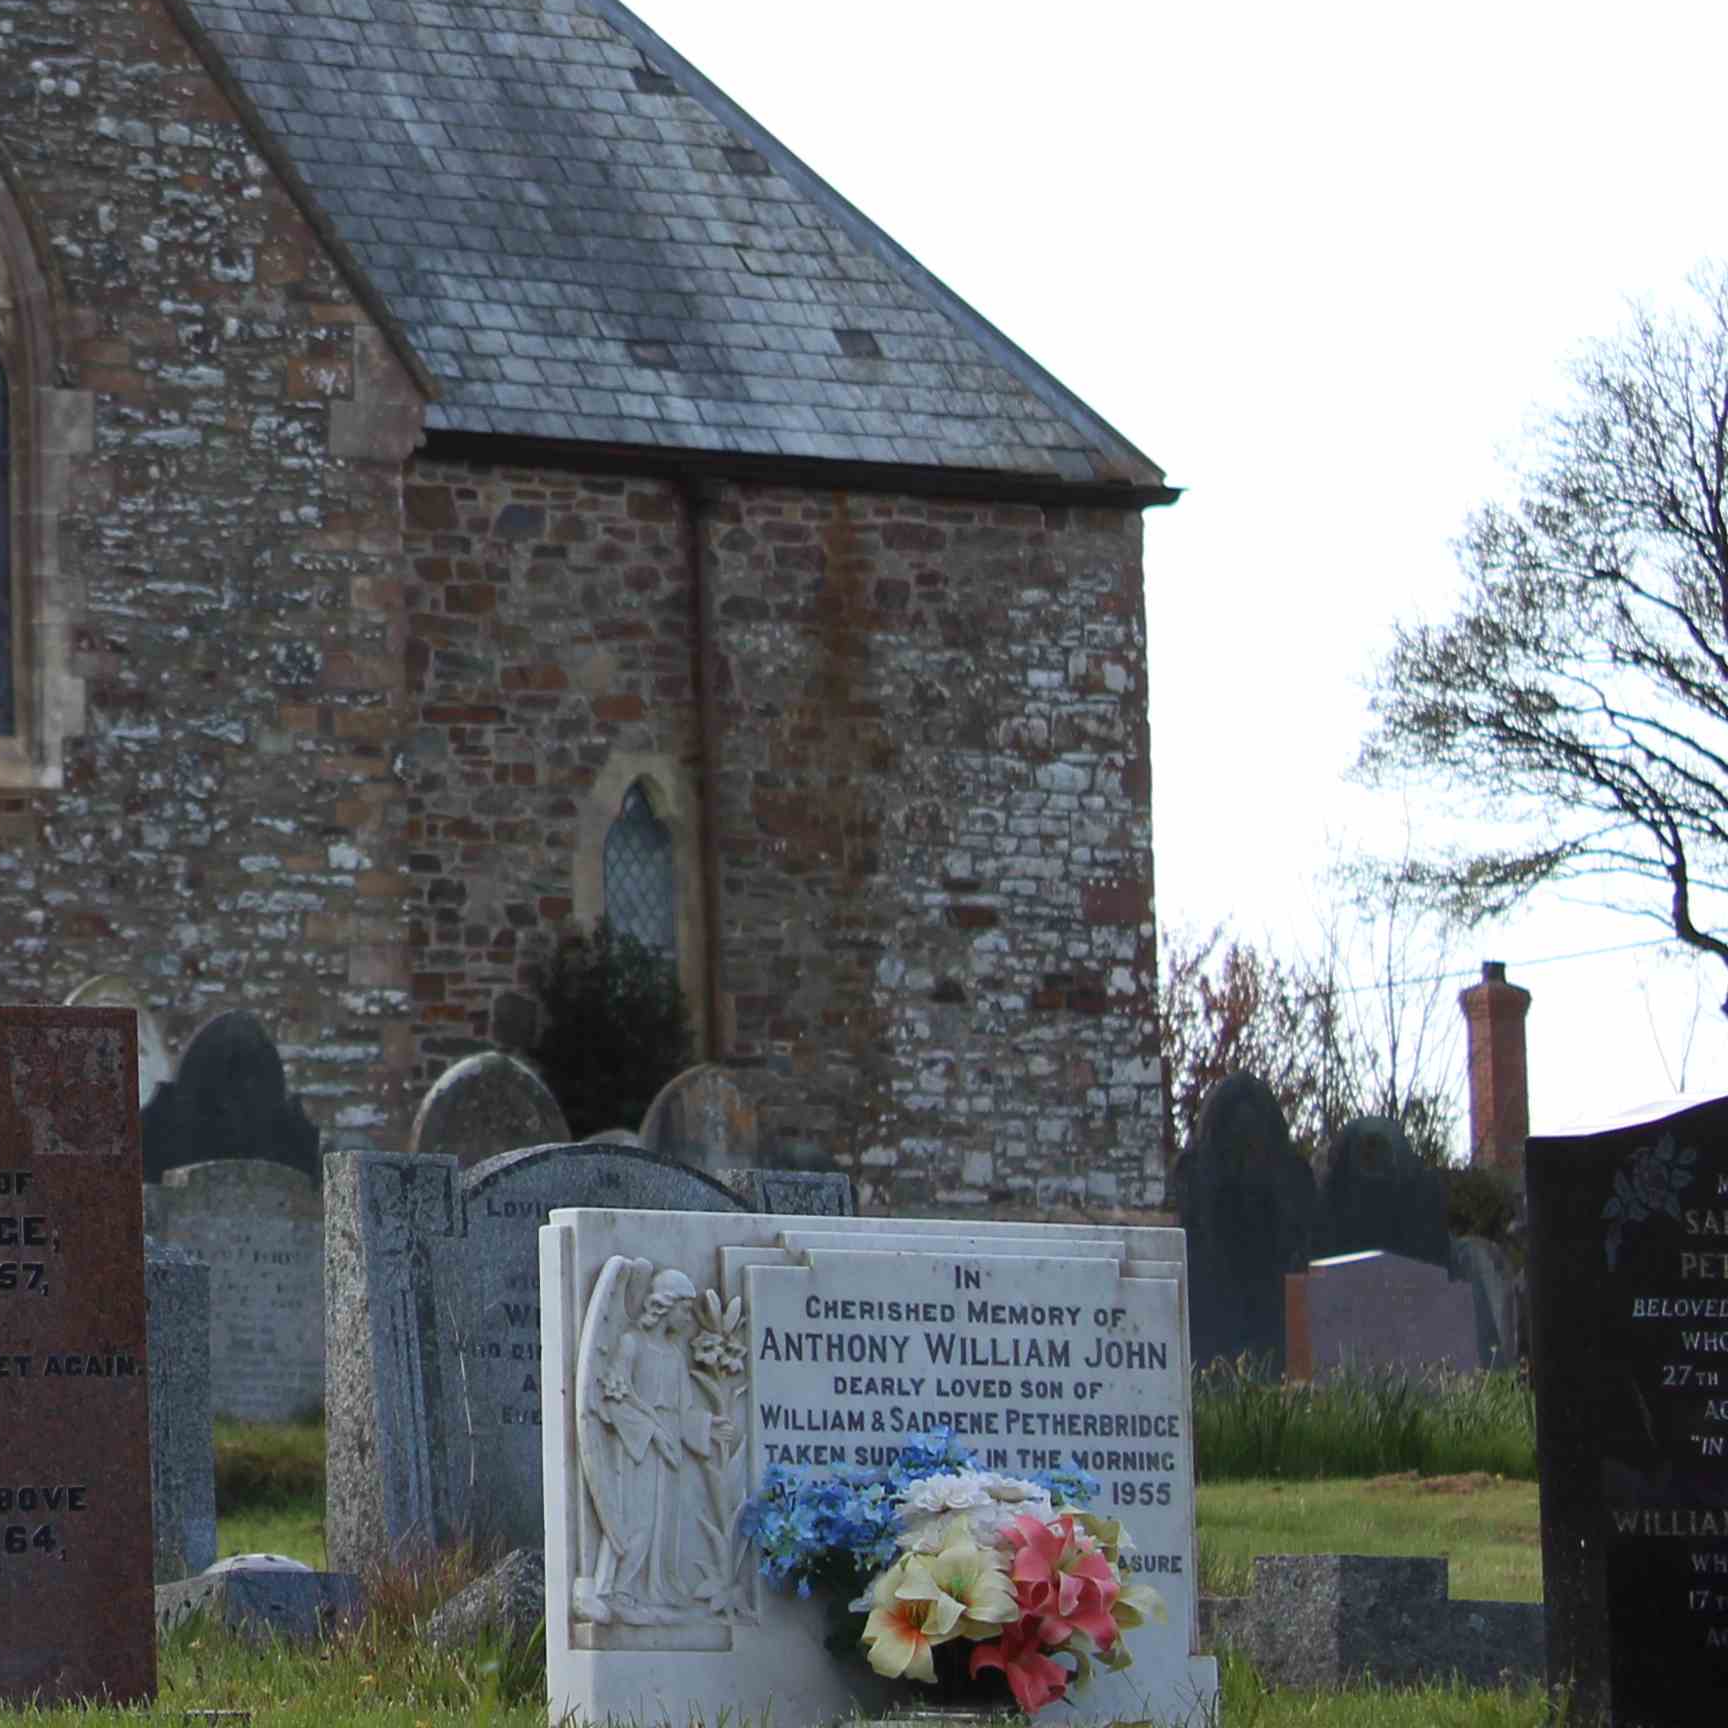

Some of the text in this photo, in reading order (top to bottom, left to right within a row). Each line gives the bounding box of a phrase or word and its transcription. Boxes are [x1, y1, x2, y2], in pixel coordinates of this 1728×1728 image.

[954, 1265, 982, 1290] IN
[806, 1296, 1127, 1329] CHERISHED MEMORY OF
[759, 1326, 1169, 1371] ANTHONY WILLIAM JOHN
[44, 1354, 146, 1379] AGAIN.
[833, 1375, 1104, 1401] DEARLY LOVED SON OF
[760, 1403, 865, 1433] WILLIAM
[871, 1410, 887, 1433] &
[1005, 1409, 1181, 1439] PETHERBRIDGE
[765, 1443, 845, 1467] TAKEN
[986, 1447, 1008, 1469] IN
[1015, 1448, 1061, 1471] THE
[1071, 1449, 1176, 1473] MORNING
[1112, 1482, 1172, 1507] 1955
